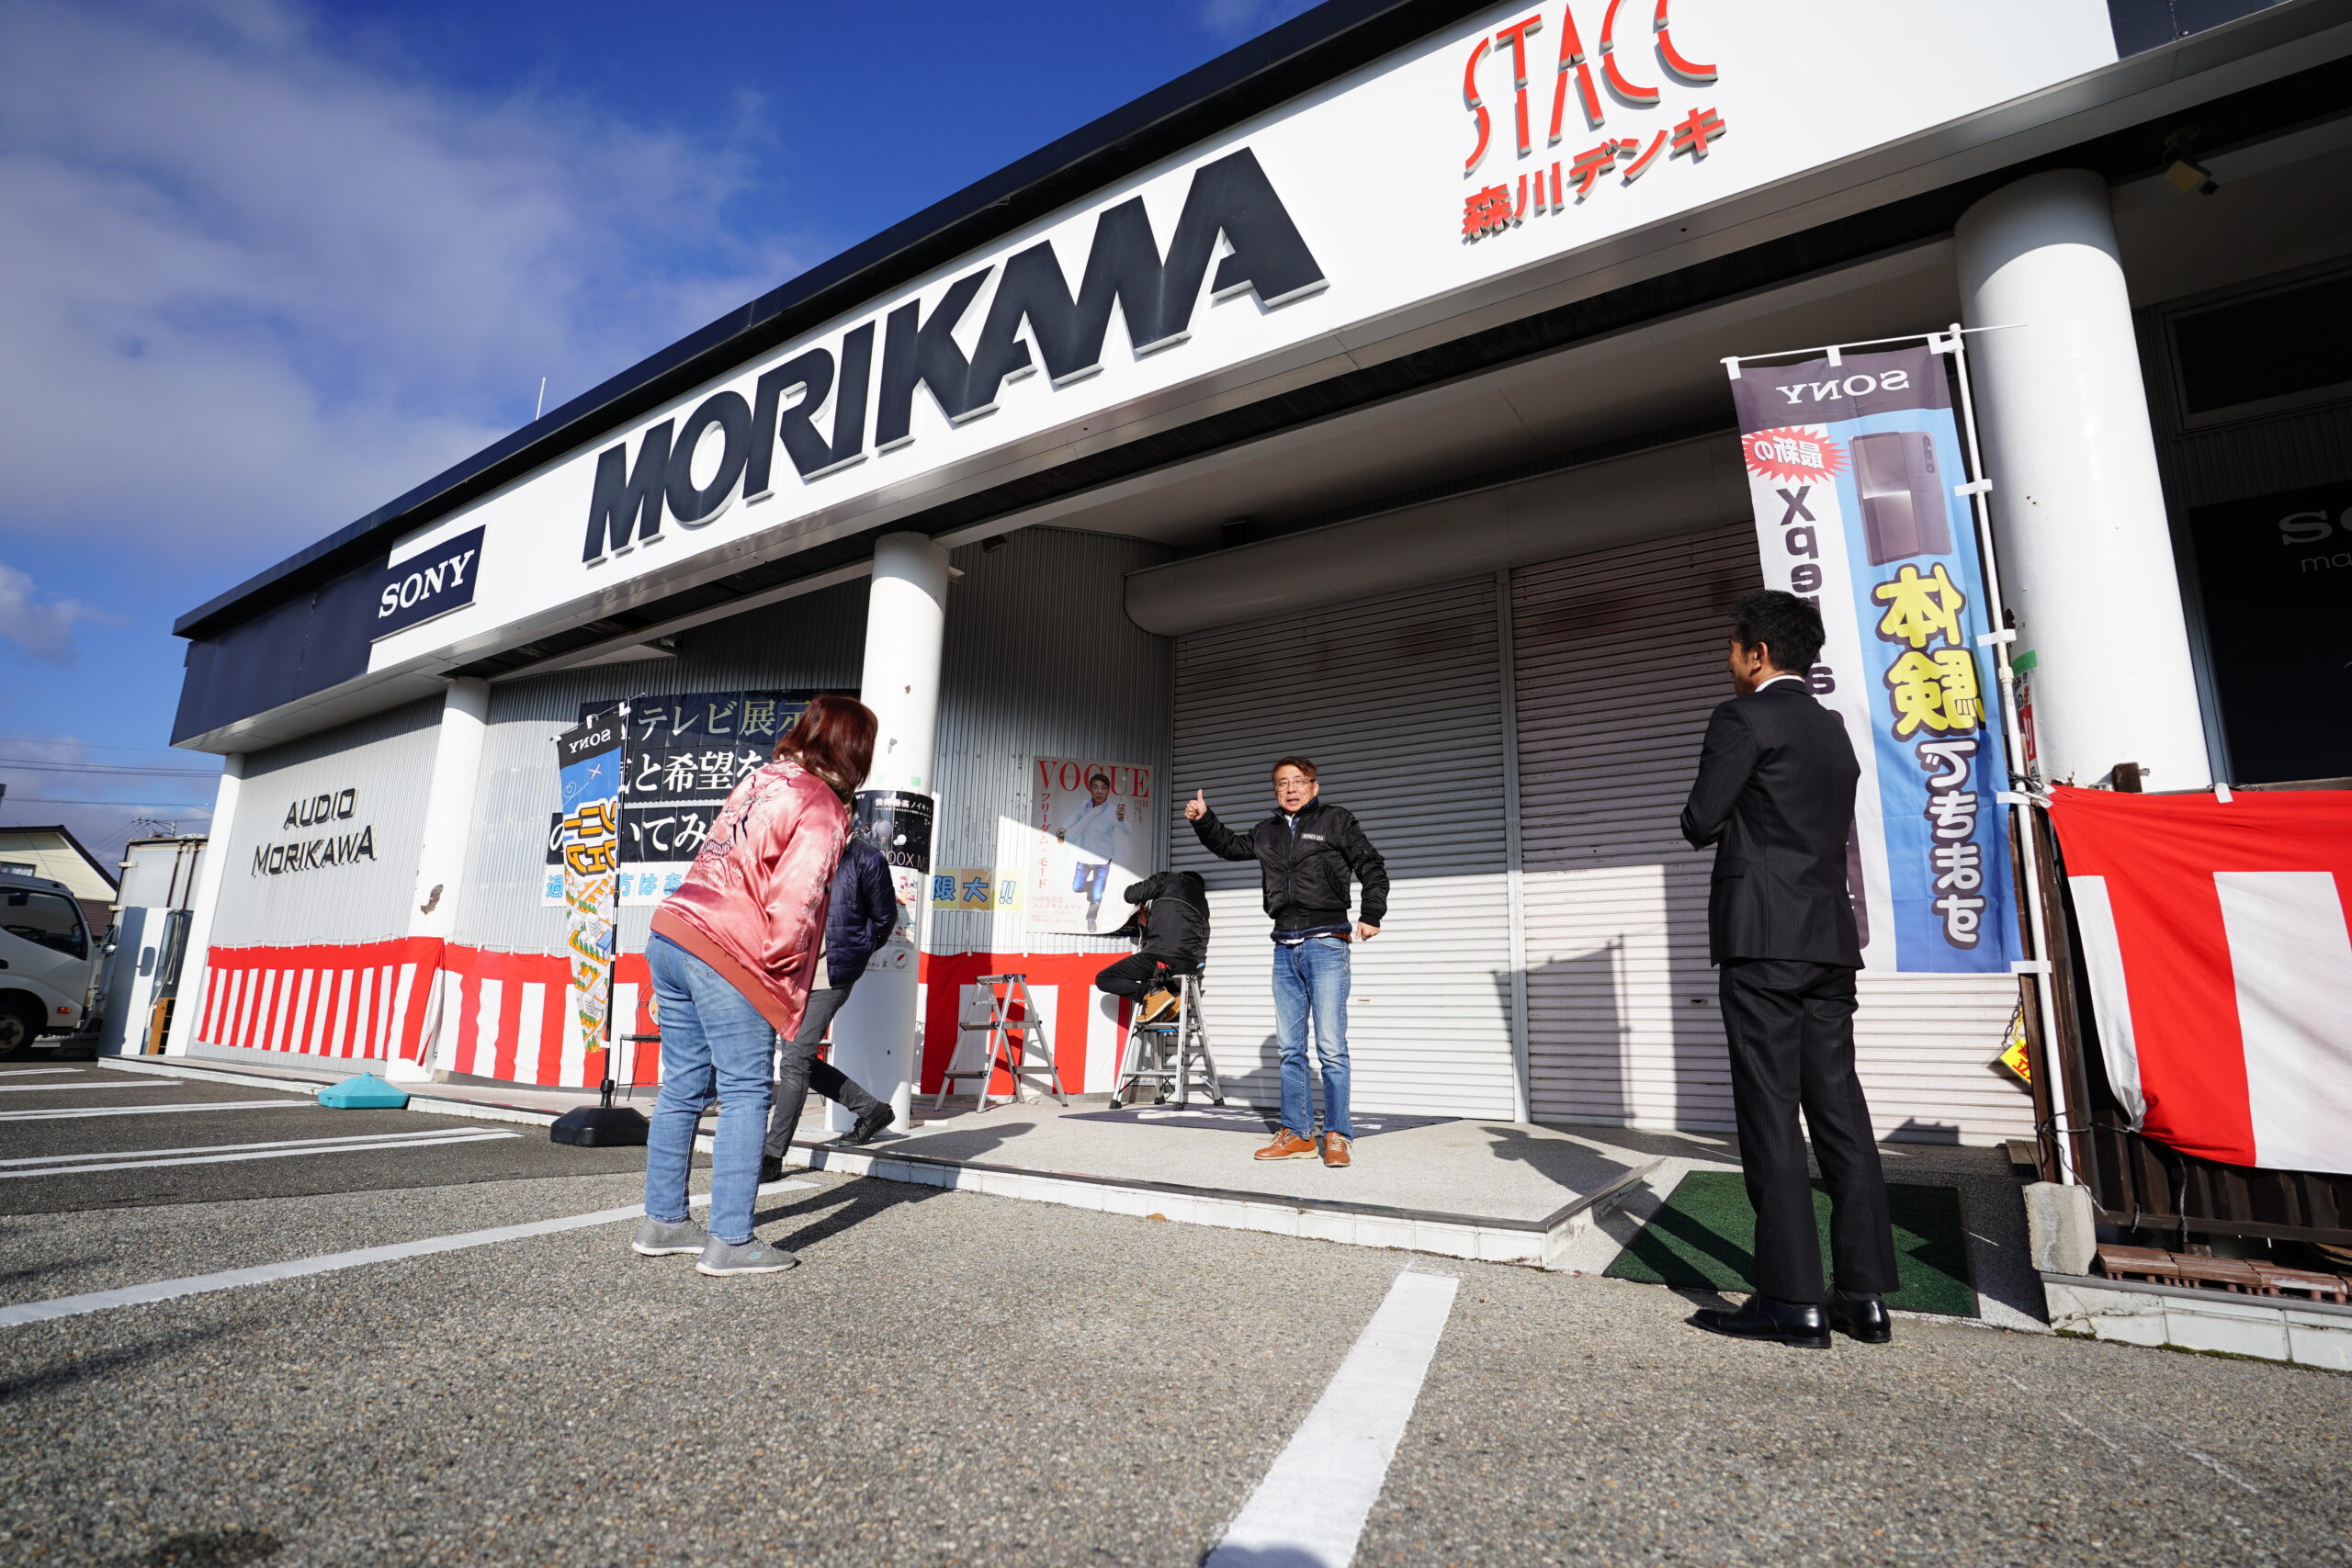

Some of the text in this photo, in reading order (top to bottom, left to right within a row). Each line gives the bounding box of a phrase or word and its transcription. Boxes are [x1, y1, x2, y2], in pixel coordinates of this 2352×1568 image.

[1462, 107, 1728, 241] 森川デンキ
[582, 146, 1330, 568] MORIKAWA
[2278, 505, 2352, 546] S
[378, 549, 475, 618] SONY
[283, 787, 359, 830] AUDIO
[252, 825, 378, 877] MORIKAWA
